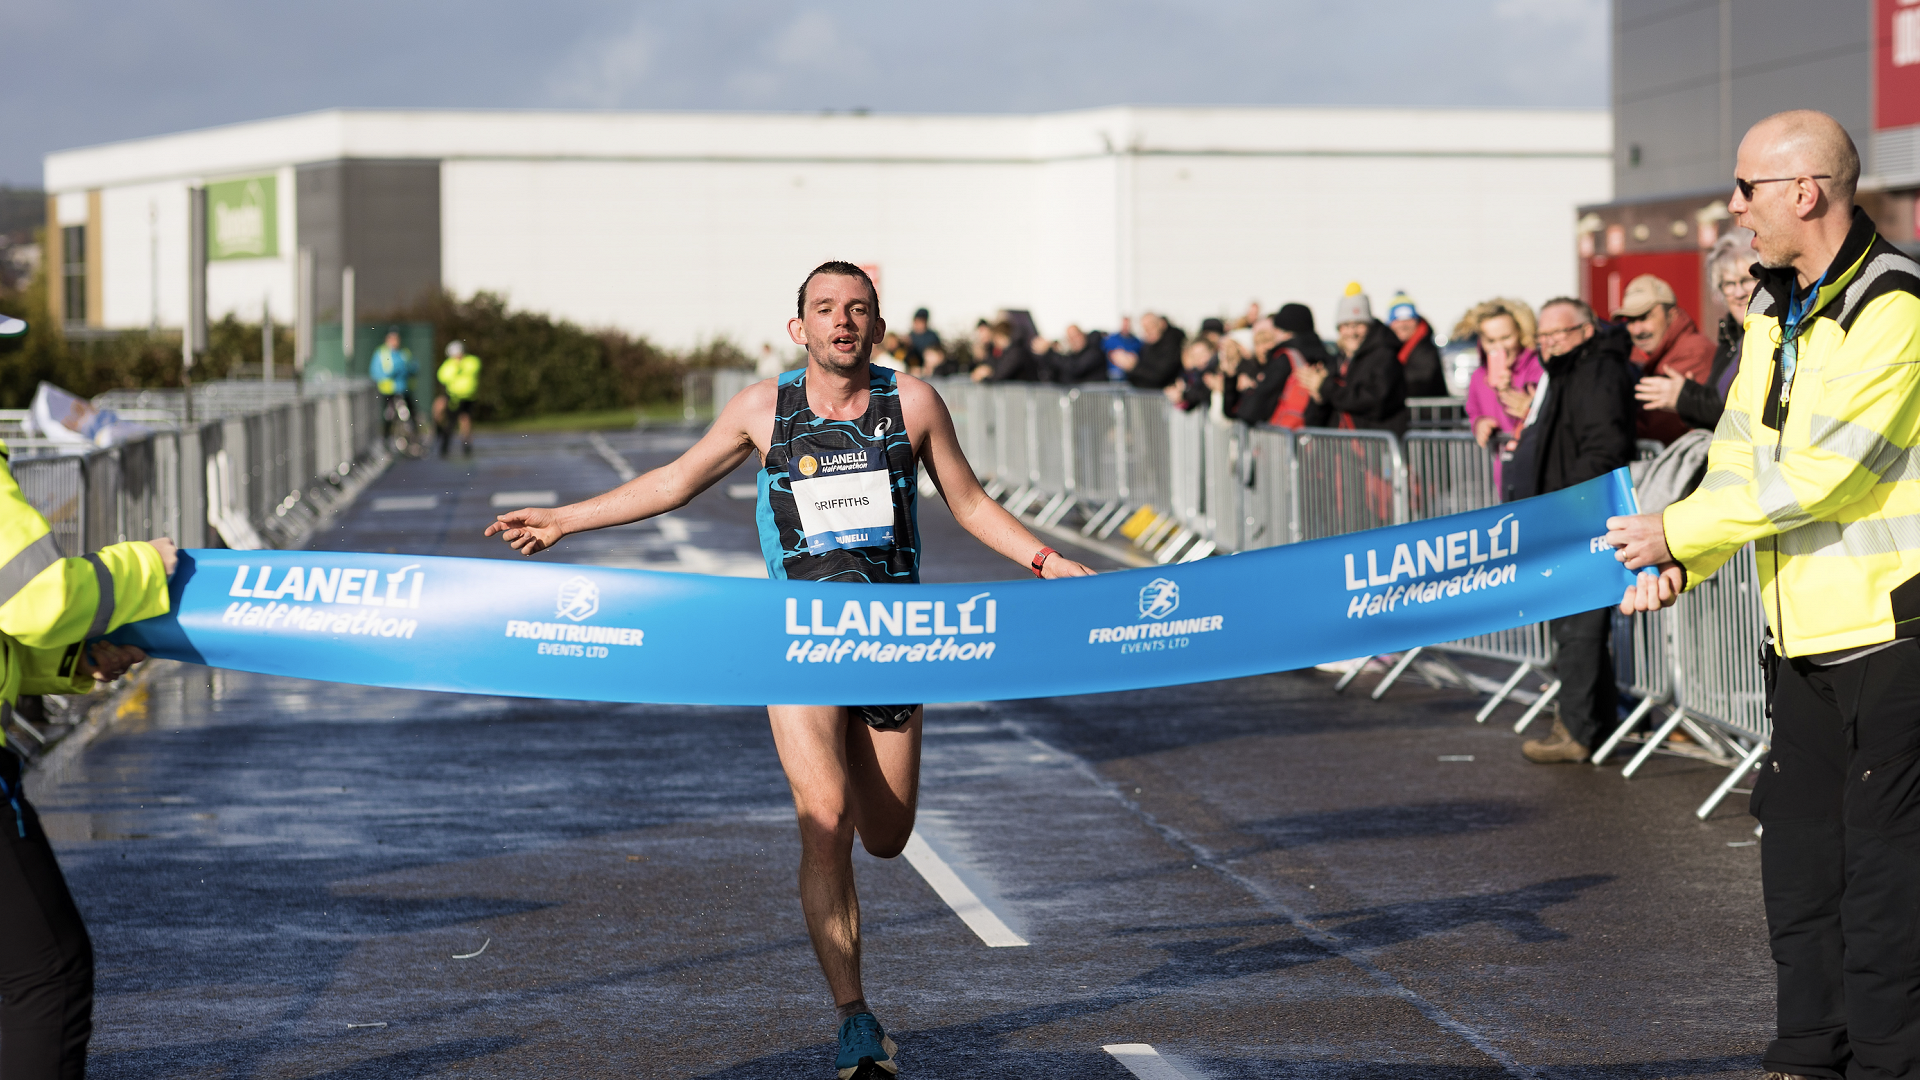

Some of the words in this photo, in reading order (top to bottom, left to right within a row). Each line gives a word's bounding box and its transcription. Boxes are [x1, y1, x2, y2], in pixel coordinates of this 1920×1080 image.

[820, 450, 868, 466] LLANELLI
[815, 496, 869, 511] GRIFFITHS
[1344, 513, 1519, 591] LLANELLI
[228, 564, 425, 609] LLANELLI
[785, 592, 997, 637] LLANELLI
[505, 620, 645, 647] FRONTRUNNER
[1088, 615, 1224, 645] FRONTRUNNER
[537, 642, 585, 658] EVENTS
[585, 645, 609, 659] LTD
[1120, 639, 1165, 655] EVENTS
[1168, 637, 1190, 649] LTD
